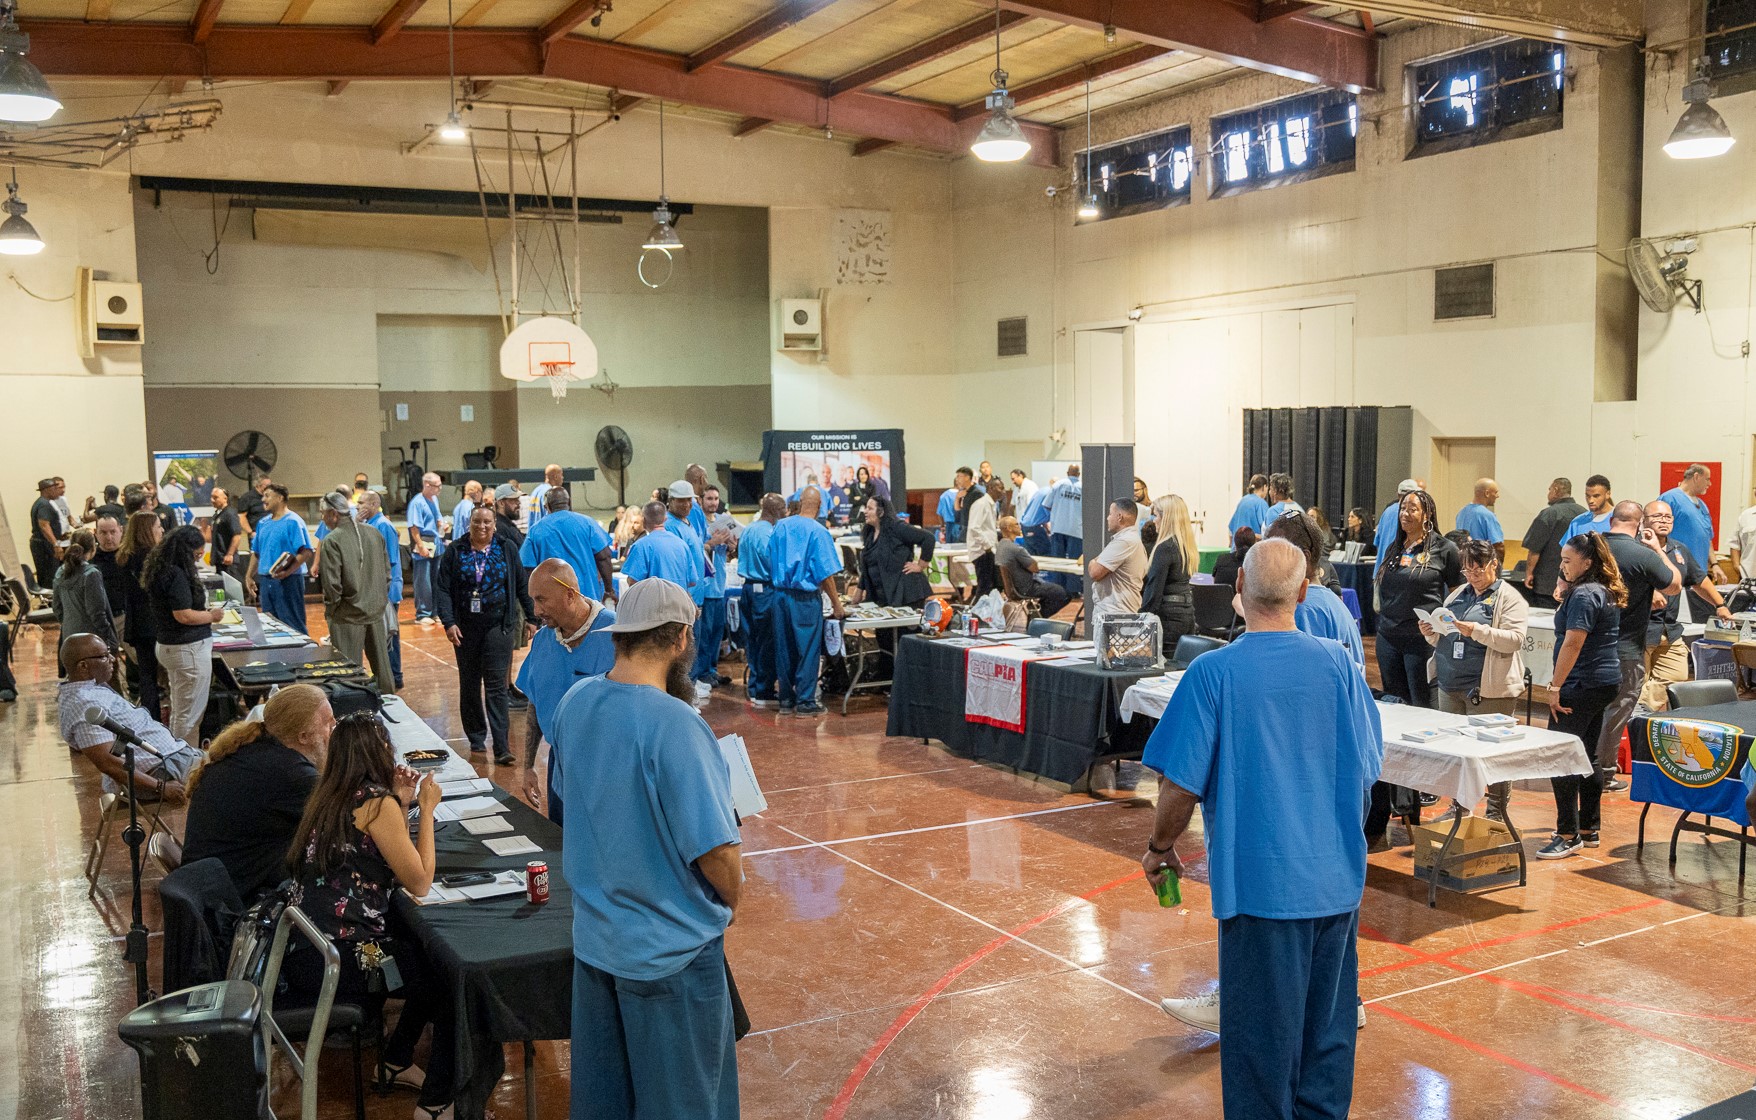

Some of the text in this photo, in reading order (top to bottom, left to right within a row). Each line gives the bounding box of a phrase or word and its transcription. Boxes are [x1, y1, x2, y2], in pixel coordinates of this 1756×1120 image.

[788, 441, 882, 451] REBUILDING LIVES
[1651, 719, 1660, 747] DEPART
[1722, 732, 1733, 761] LITATION
[1660, 756, 1721, 782] STATE OF CALIFORNIA
